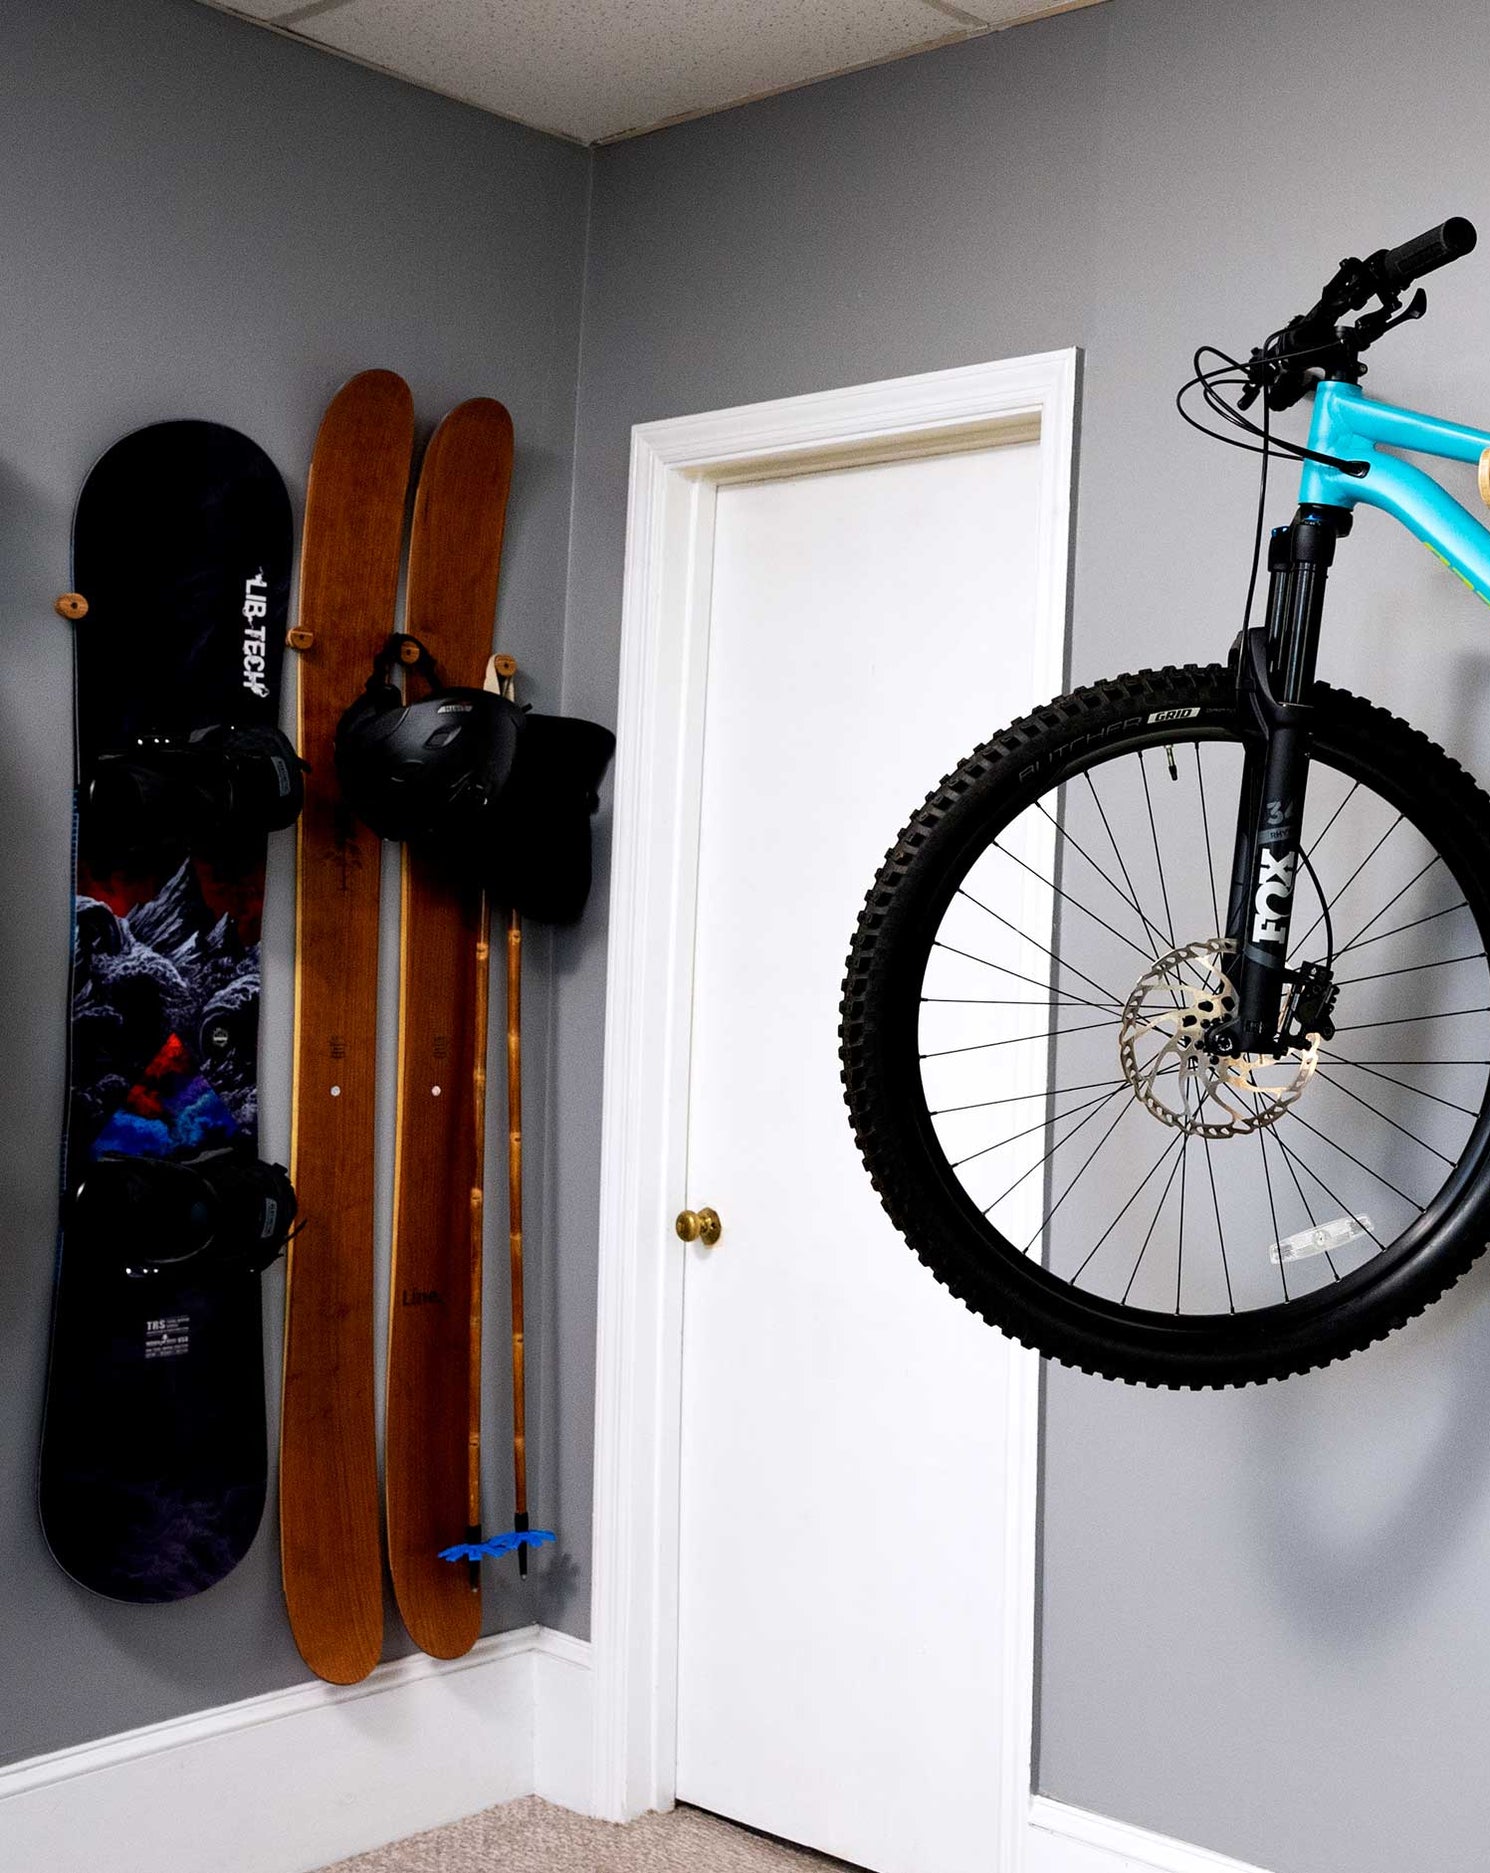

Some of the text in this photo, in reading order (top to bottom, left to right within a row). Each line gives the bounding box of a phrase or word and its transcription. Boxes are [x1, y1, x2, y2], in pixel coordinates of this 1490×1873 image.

[241, 568, 270, 698] LIB TECH
[1154, 708, 1193, 723] GRID
[1251, 847, 1299, 945] FOX
[146, 1319, 166, 1332] TRS
